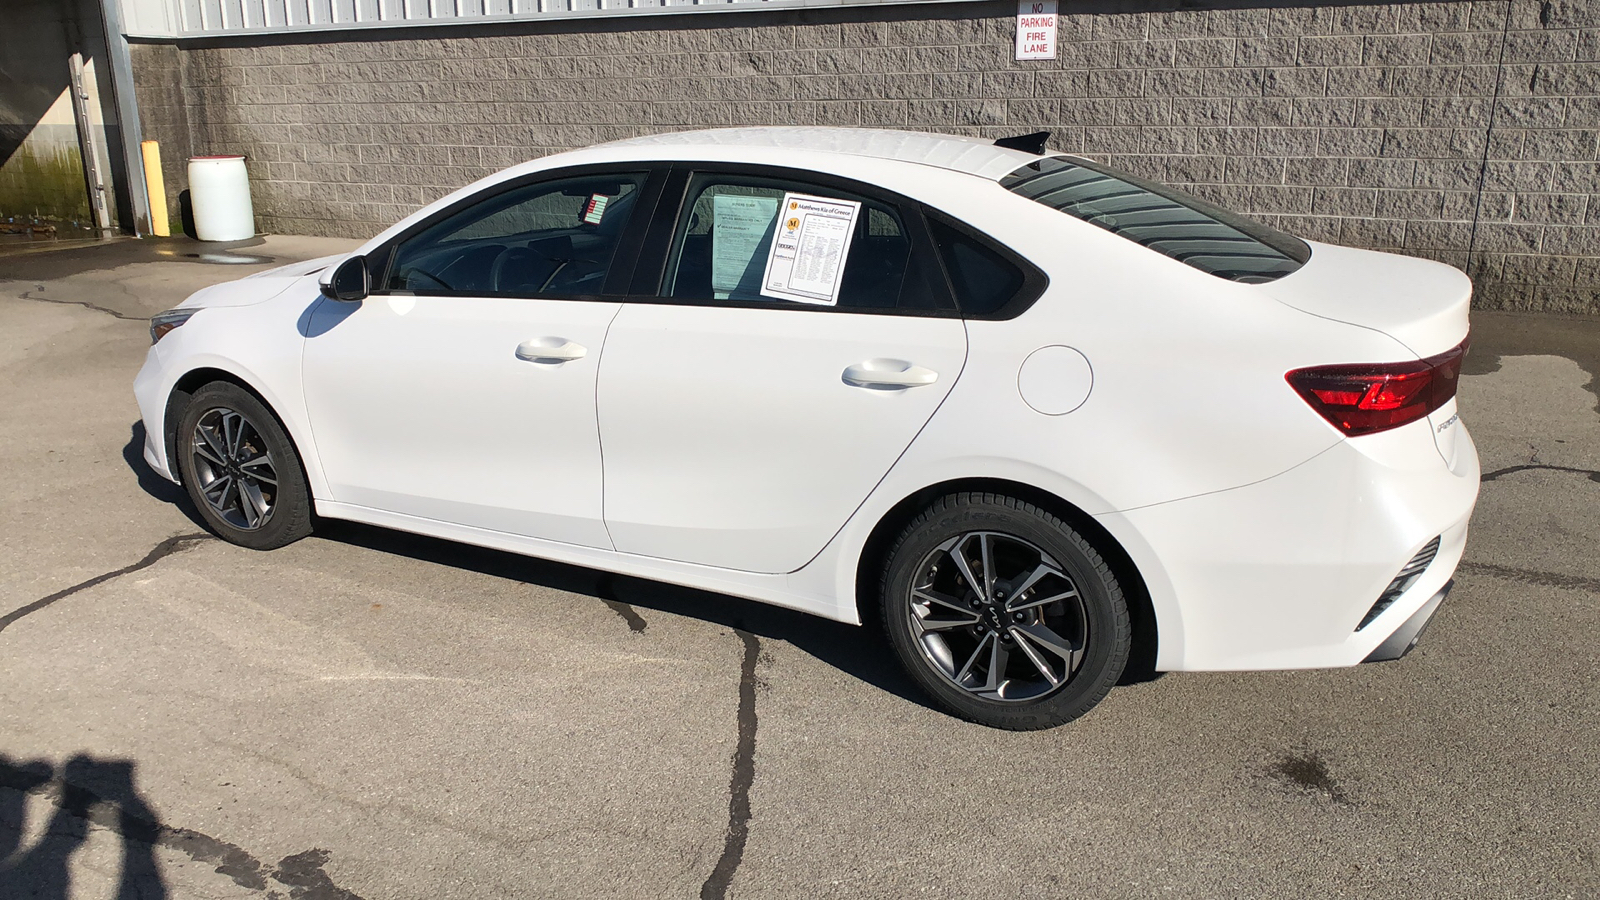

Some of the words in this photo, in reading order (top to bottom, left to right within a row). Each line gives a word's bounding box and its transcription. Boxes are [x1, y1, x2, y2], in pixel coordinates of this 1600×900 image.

[1032, 3, 1043, 13] NO
[1021, 17, 1053, 28] PARKING
[1026, 32, 1047, 41] FIRE
[1024, 44, 1048, 53] LANE
[798, 204, 820, 212] Matthews
